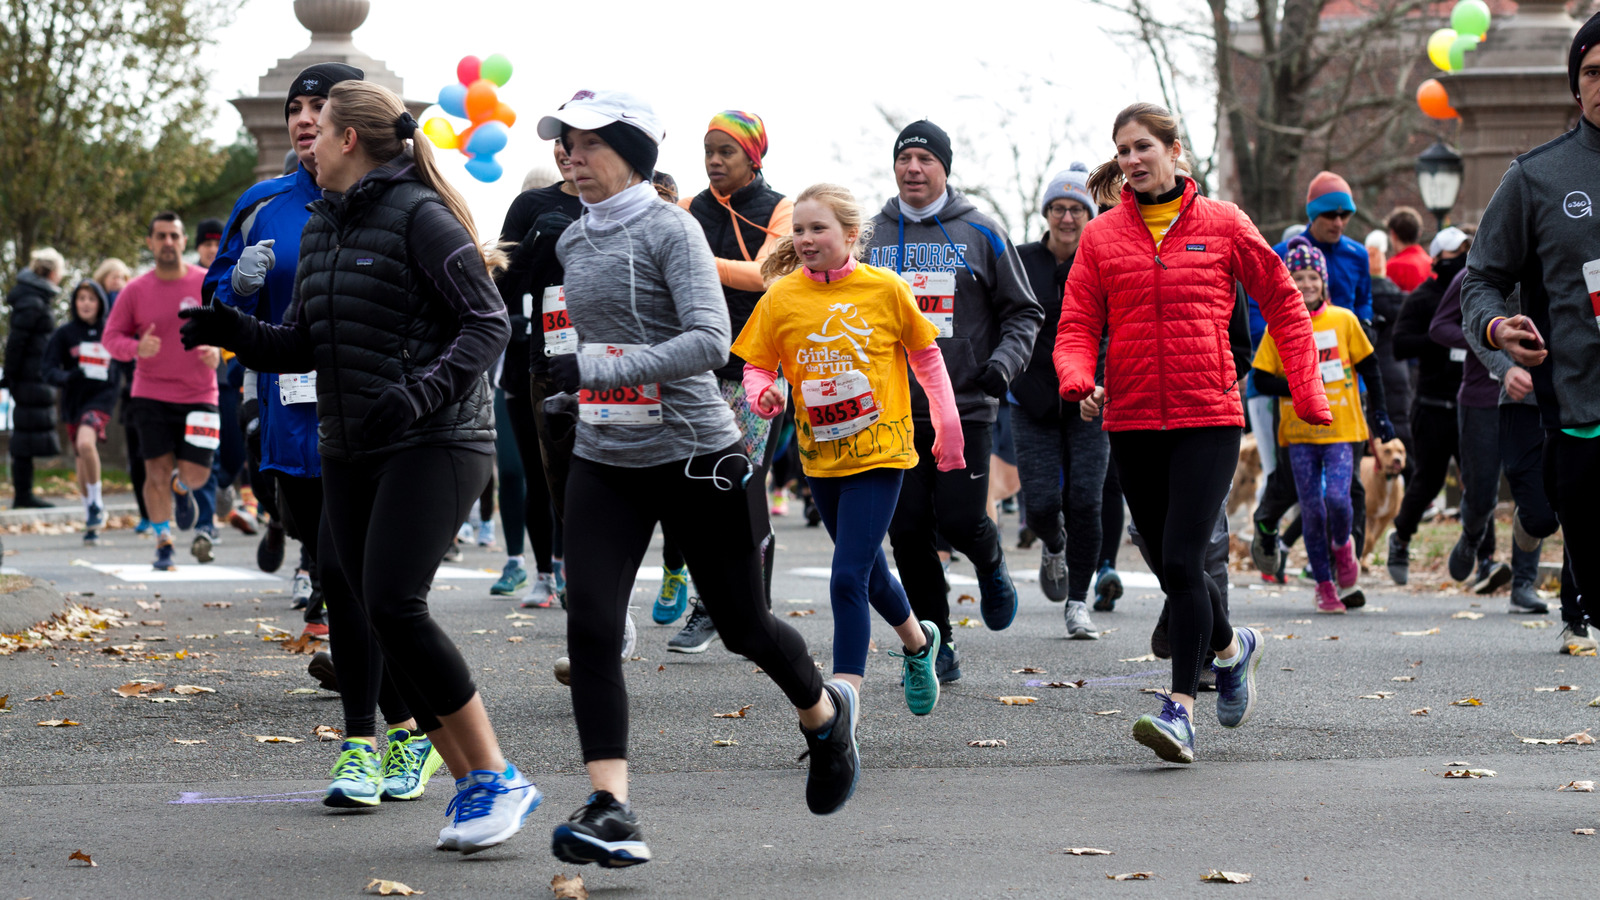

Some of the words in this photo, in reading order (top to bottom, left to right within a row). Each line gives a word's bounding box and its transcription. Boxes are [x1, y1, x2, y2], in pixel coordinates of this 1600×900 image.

[869, 244, 899, 268] AIR
[904, 243, 967, 267] FORCE
[915, 296, 940, 312] 07
[546, 311, 573, 330] 36
[796, 346, 840, 364] Girls
[806, 364, 818, 372] the
[818, 361, 854, 375] run
[813, 399, 860, 424] 3653
